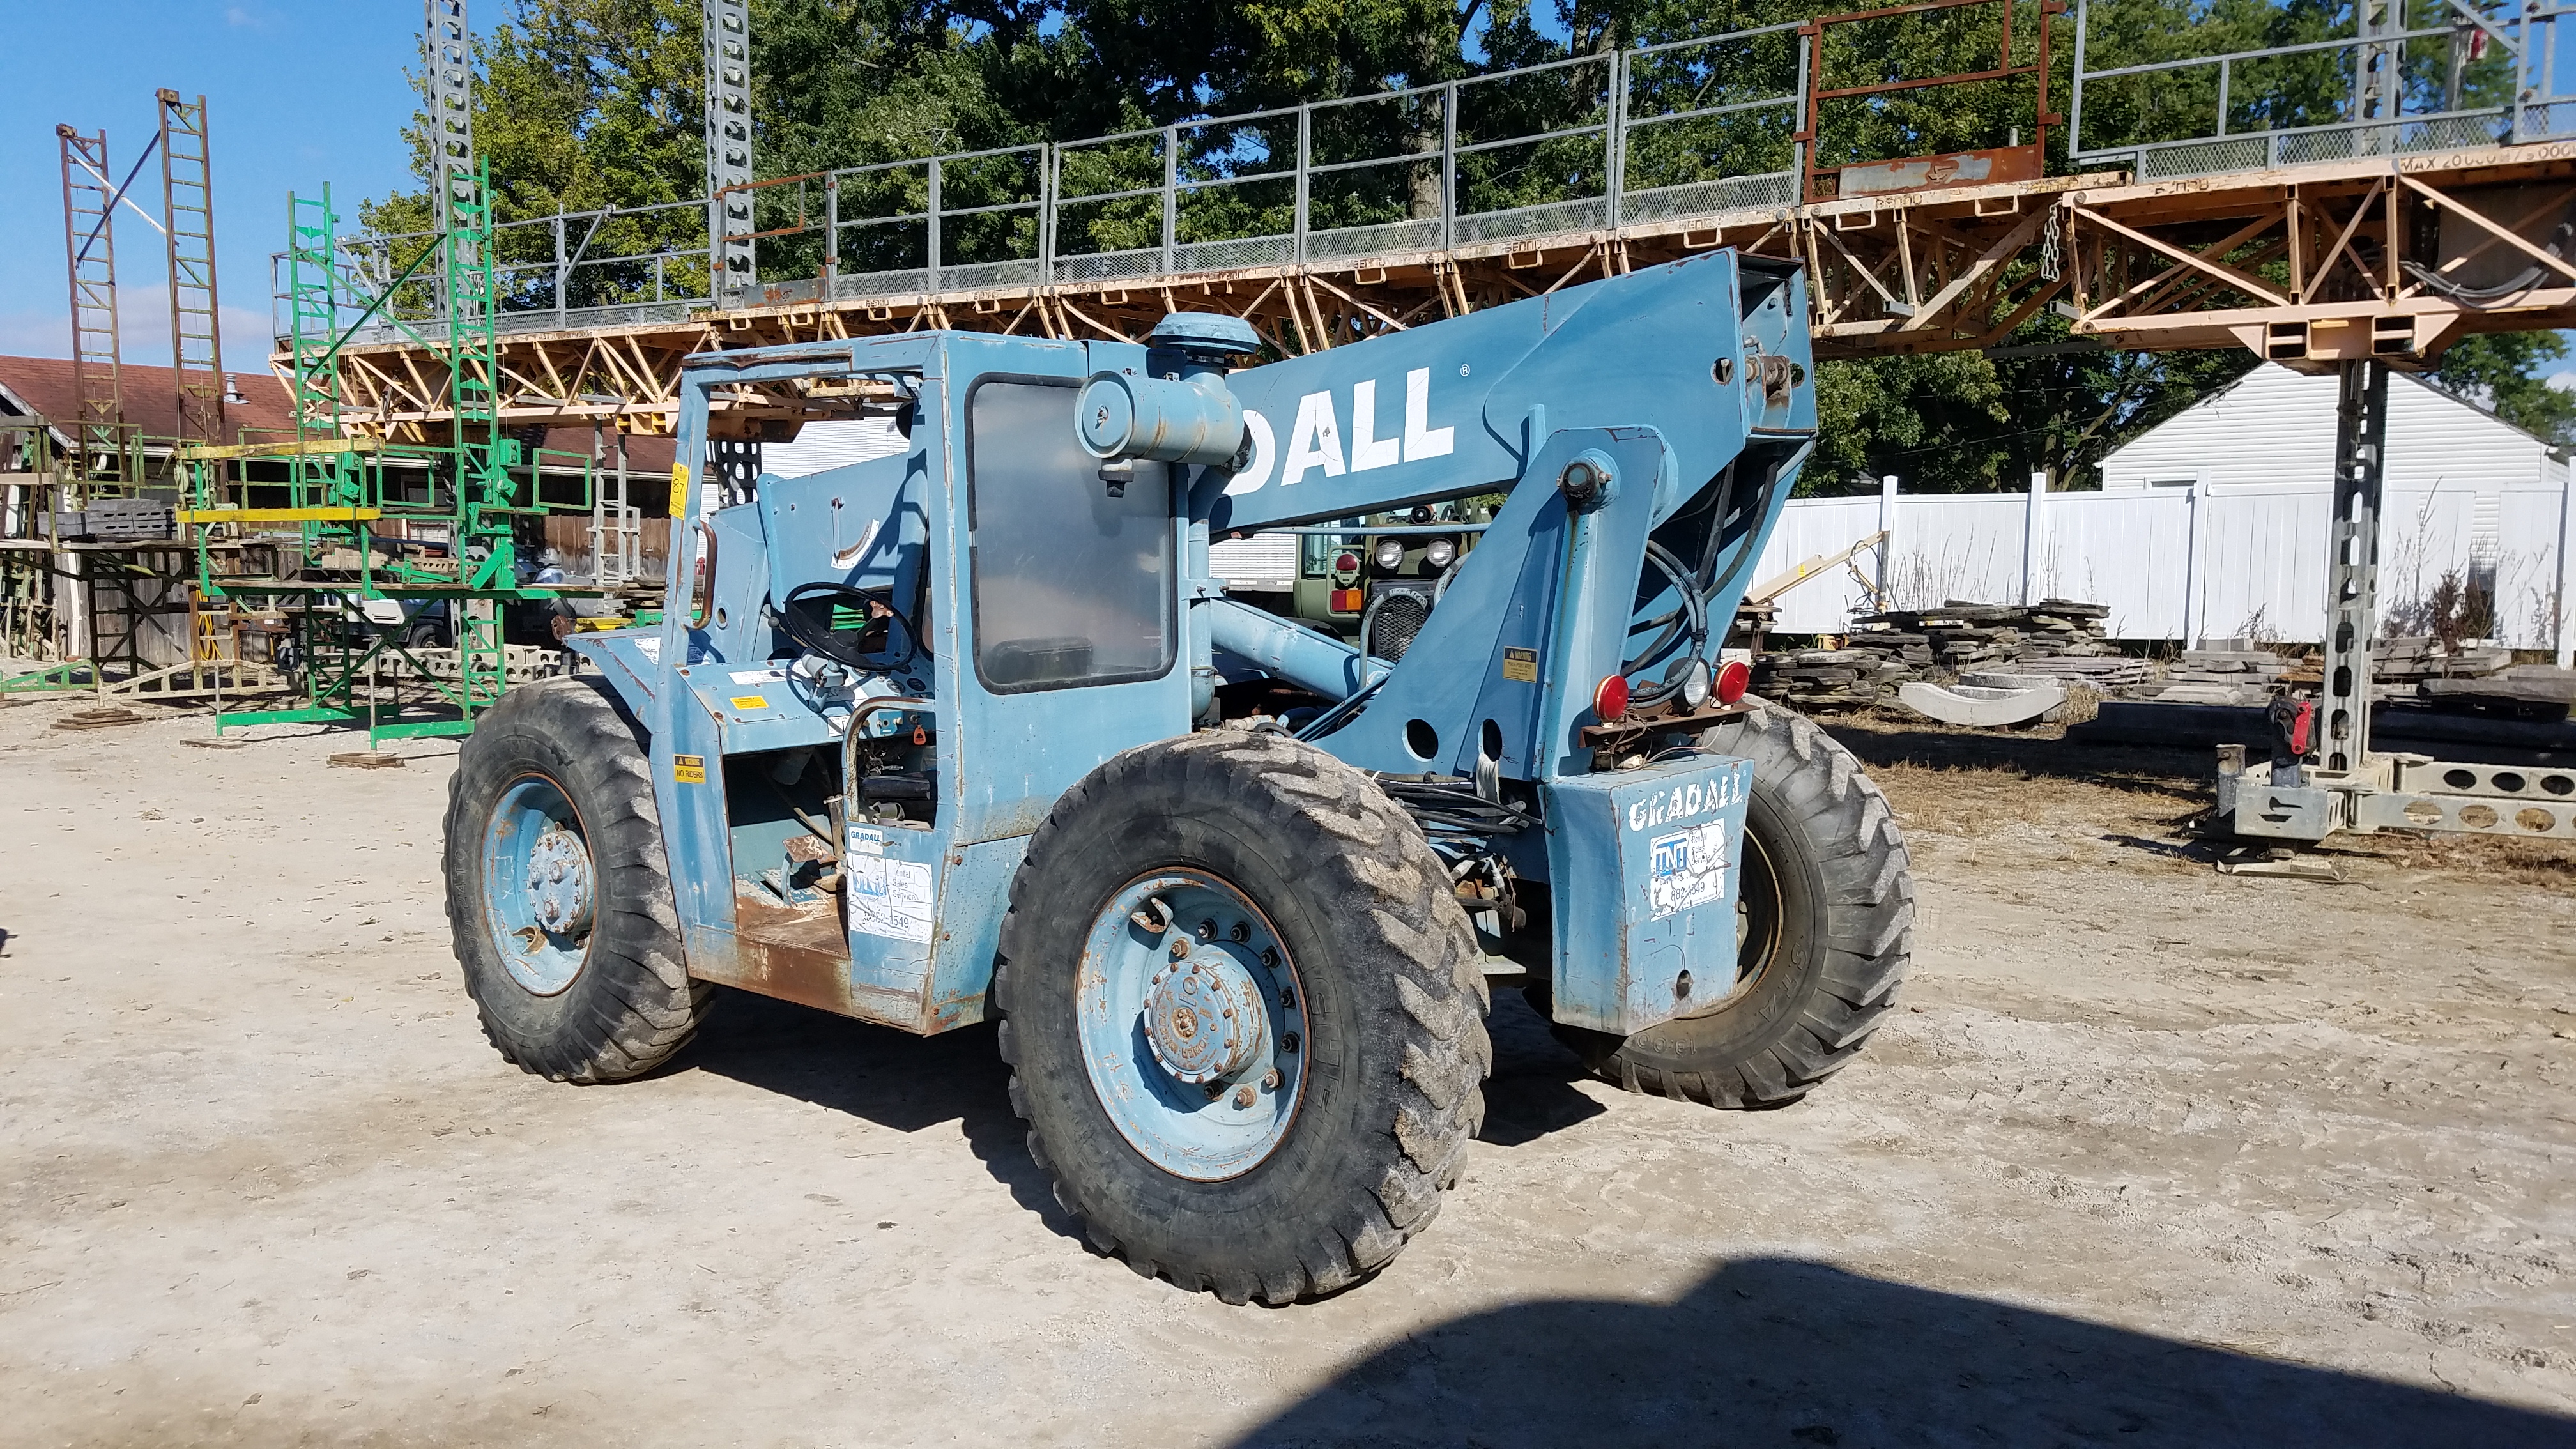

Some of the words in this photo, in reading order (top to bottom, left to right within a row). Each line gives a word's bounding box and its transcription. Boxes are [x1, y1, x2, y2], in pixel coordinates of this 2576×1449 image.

[673, 478, 684, 496] 87
[685, 770, 703, 779] RIDERS
[850, 831, 880, 842] GRADALL
[893, 878, 908, 889] Sales
